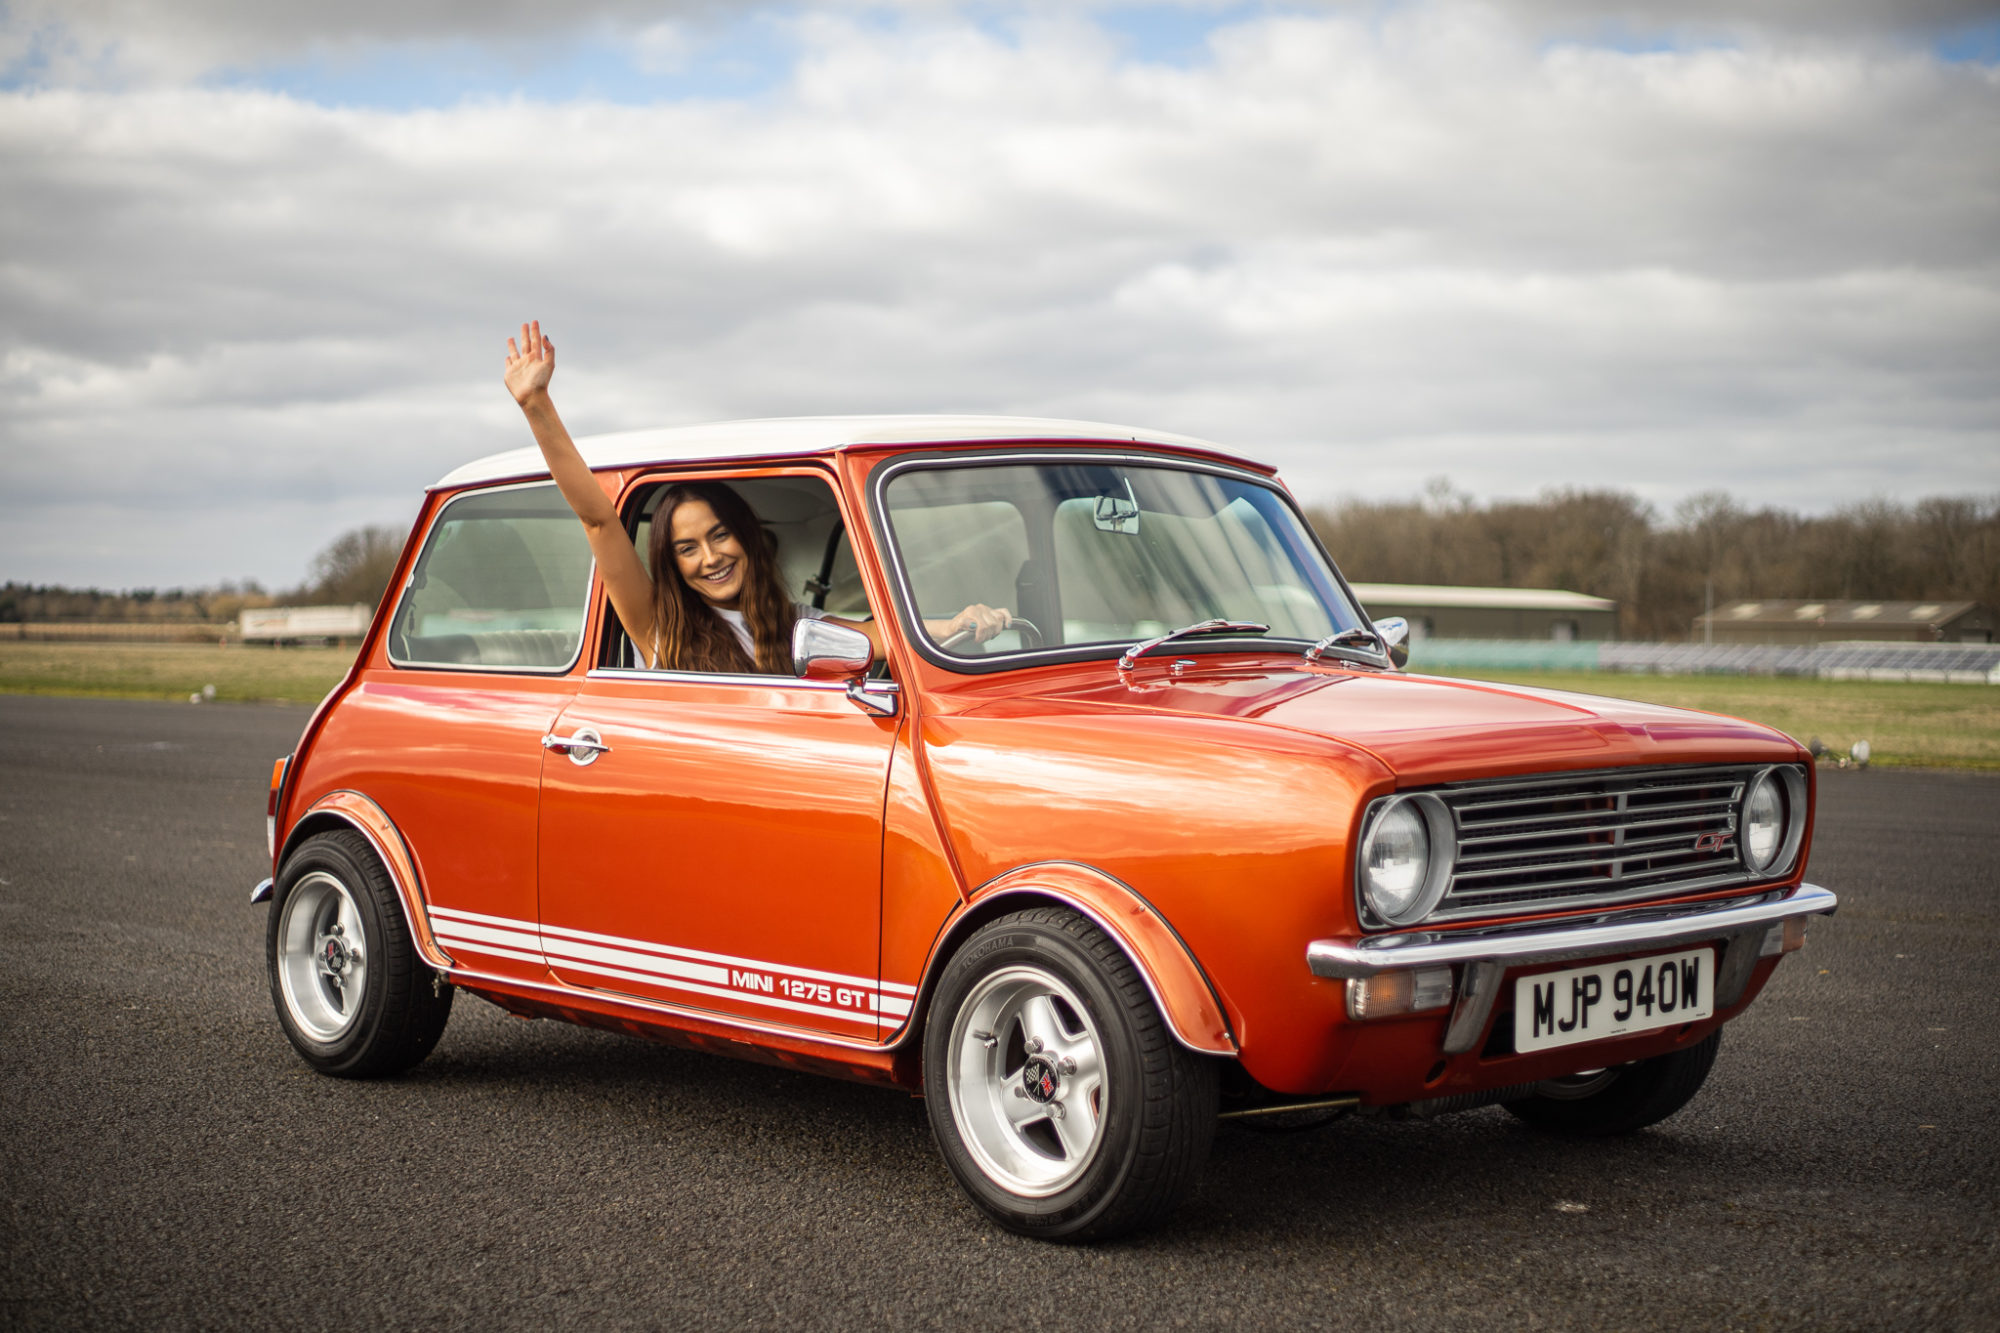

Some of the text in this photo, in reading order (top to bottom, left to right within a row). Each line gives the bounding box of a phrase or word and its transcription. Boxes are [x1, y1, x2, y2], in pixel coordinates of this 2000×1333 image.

[1695, 831, 1734, 852] GT
[962, 935, 1014, 969] YOKOHAMA
[731, 969, 865, 1008] MINI 1275 GT
[1533, 956, 1700, 1038] MJP 940W
